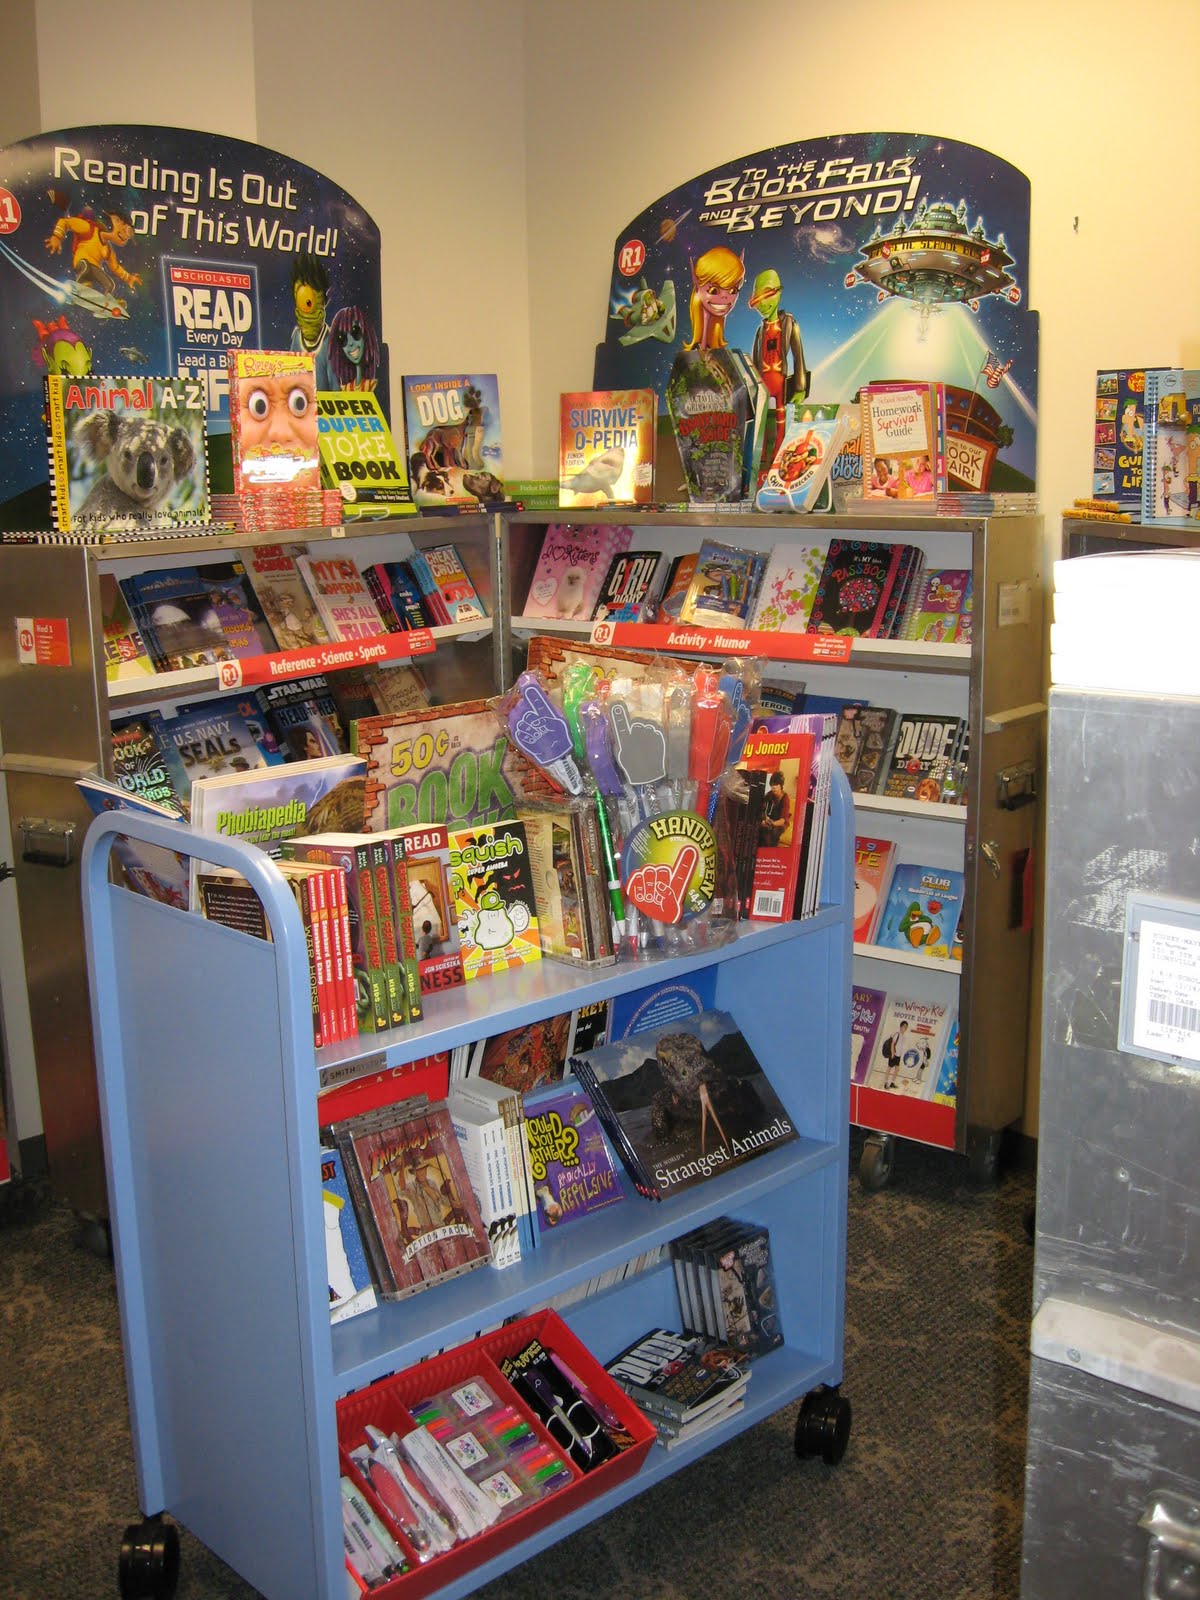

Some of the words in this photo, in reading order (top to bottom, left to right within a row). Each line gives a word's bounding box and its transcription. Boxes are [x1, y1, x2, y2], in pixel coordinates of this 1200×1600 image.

[54, 146, 200, 203] Reading
[208, 167, 234, 201] Is
[241, 173, 298, 211] Out
[777, 160, 817, 177] THE
[704, 173, 812, 206] BOOK
[0, 197, 18, 223] 1
[699, 209, 731, 222] AND
[726, 175, 921, 233] BEYOND!
[132, 204, 168, 237] of
[176, 207, 240, 246] This
[245, 215, 339, 257] World!
[621, 246, 641, 268] R1
[183, 272, 249, 286] SCHOLASTIC
[172, 286, 252, 333] READ
[186, 330, 218, 346] Every
[222, 332, 243, 347] Day
[177, 353, 206, 367] Lead
[209, 358, 216, 367] a
[65, 381, 153, 410] Animal
[161, 385, 201, 410] A-Z
[410, 382, 433, 393] LOOK
[435, 380, 460, 391] INSIDE
[462, 379, 470, 388] A
[53, 399, 61, 423] smart
[416, 389, 464, 427] DOG
[570, 407, 644, 429] SURVIVE-
[872, 402, 922, 418] Homework
[318, 416, 385, 433] DUPER
[877, 408, 918, 431] Survival
[575, 429, 638, 450] O-PEDIA
[886, 425, 913, 437] Guide
[324, 433, 392, 464] JOKE
[947, 446, 981, 471] OOK
[960, 442, 967, 450] to
[969, 446, 982, 455] our
[57, 452, 65, 475] smart
[332, 460, 401, 481] BOOK
[947, 460, 975, 481] AIR!
[790, 470, 815, 489] WRECKED
[1122, 476, 1142, 489] LIF
[73, 514, 87, 523] For
[89, 512, 107, 523] kids
[109, 510, 127, 521] who
[128, 508, 153, 521] really
[154, 508, 172, 519] love
[174, 505, 206, 518] animals!
[425, 549, 456, 564] CHEAT
[563, 544, 599, 566] Kittens
[431, 561, 462, 577] CODE
[832, 564, 888, 583] PASSBOO
[614, 591, 644, 603] DIARY
[331, 607, 358, 621] SHE'S
[358, 606, 377, 618] ALL
[20, 634, 32, 646] R1
[49, 625, 53, 633] 1
[595, 627, 608, 638] R1
[667, 632, 706, 648] Activity
[714, 635, 751, 649] Humor
[223, 668, 239, 682] R1
[270, 655, 316, 676] Reference
[321, 652, 354, 668] Science
[359, 643, 387, 661] Sports
[268, 683, 302, 700] STAR
[386, 686, 418, 702] Dinosaurs
[400, 695, 420, 711] Action
[196, 721, 231, 740] NAVY
[895, 721, 957, 760] DUDE
[113, 743, 146, 761] OOK
[179, 737, 241, 767] SEALS
[390, 730, 449, 777] 50¢
[755, 741, 789, 755] Jonas!
[124, 762, 136, 771] OF
[388, 738, 514, 831] BOOK
[216, 799, 307, 836] Phobiapedia
[404, 833, 441, 851] READ
[450, 832, 523, 867] squish
[650, 816, 714, 850] HANDY
[699, 852, 716, 899] PEN
[467, 865, 486, 876] SUPER
[922, 875, 951, 886] CLUB
[359, 870, 375, 922] CREATURE
[322, 920, 330, 957] Snowboard
[333, 918, 342, 956] Snowboard
[343, 915, 351, 953] Snowboard
[375, 866, 391, 917] CREATURE
[388, 978, 396, 998] KIDS
[396, 862, 410, 913] CREATURE
[407, 973, 415, 993] KIDS
[304, 925, 315, 959] WAR
[313, 922, 322, 960] Snowboard
[325, 959, 333, 982] Champ
[425, 965, 435, 974] JON
[435, 959, 461, 972] SCIESZKA
[309, 964, 319, 1014] HORSE
[420, 966, 462, 991] NESS
[860, 1008, 876, 1024] Kid
[894, 1012, 915, 1021] MOVIE
[917, 1016, 938, 1025] DIARY
[904, 1001, 930, 1016] Wimpy
[931, 1004, 945, 1018] Kid
[534, 1132, 554, 1146] YOU
[655, 1146, 730, 1188] Strangest
[731, 1118, 792, 1157] Animals
[663, 1153, 685, 1166] WORLD'S
[558, 1161, 596, 1188] RADICALLY
[559, 1170, 613, 1213] REPULSIVE
[408, 1233, 438, 1255] ACTION
[443, 1226, 465, 1236] PACK
[608, 1330, 698, 1385] DUDE
